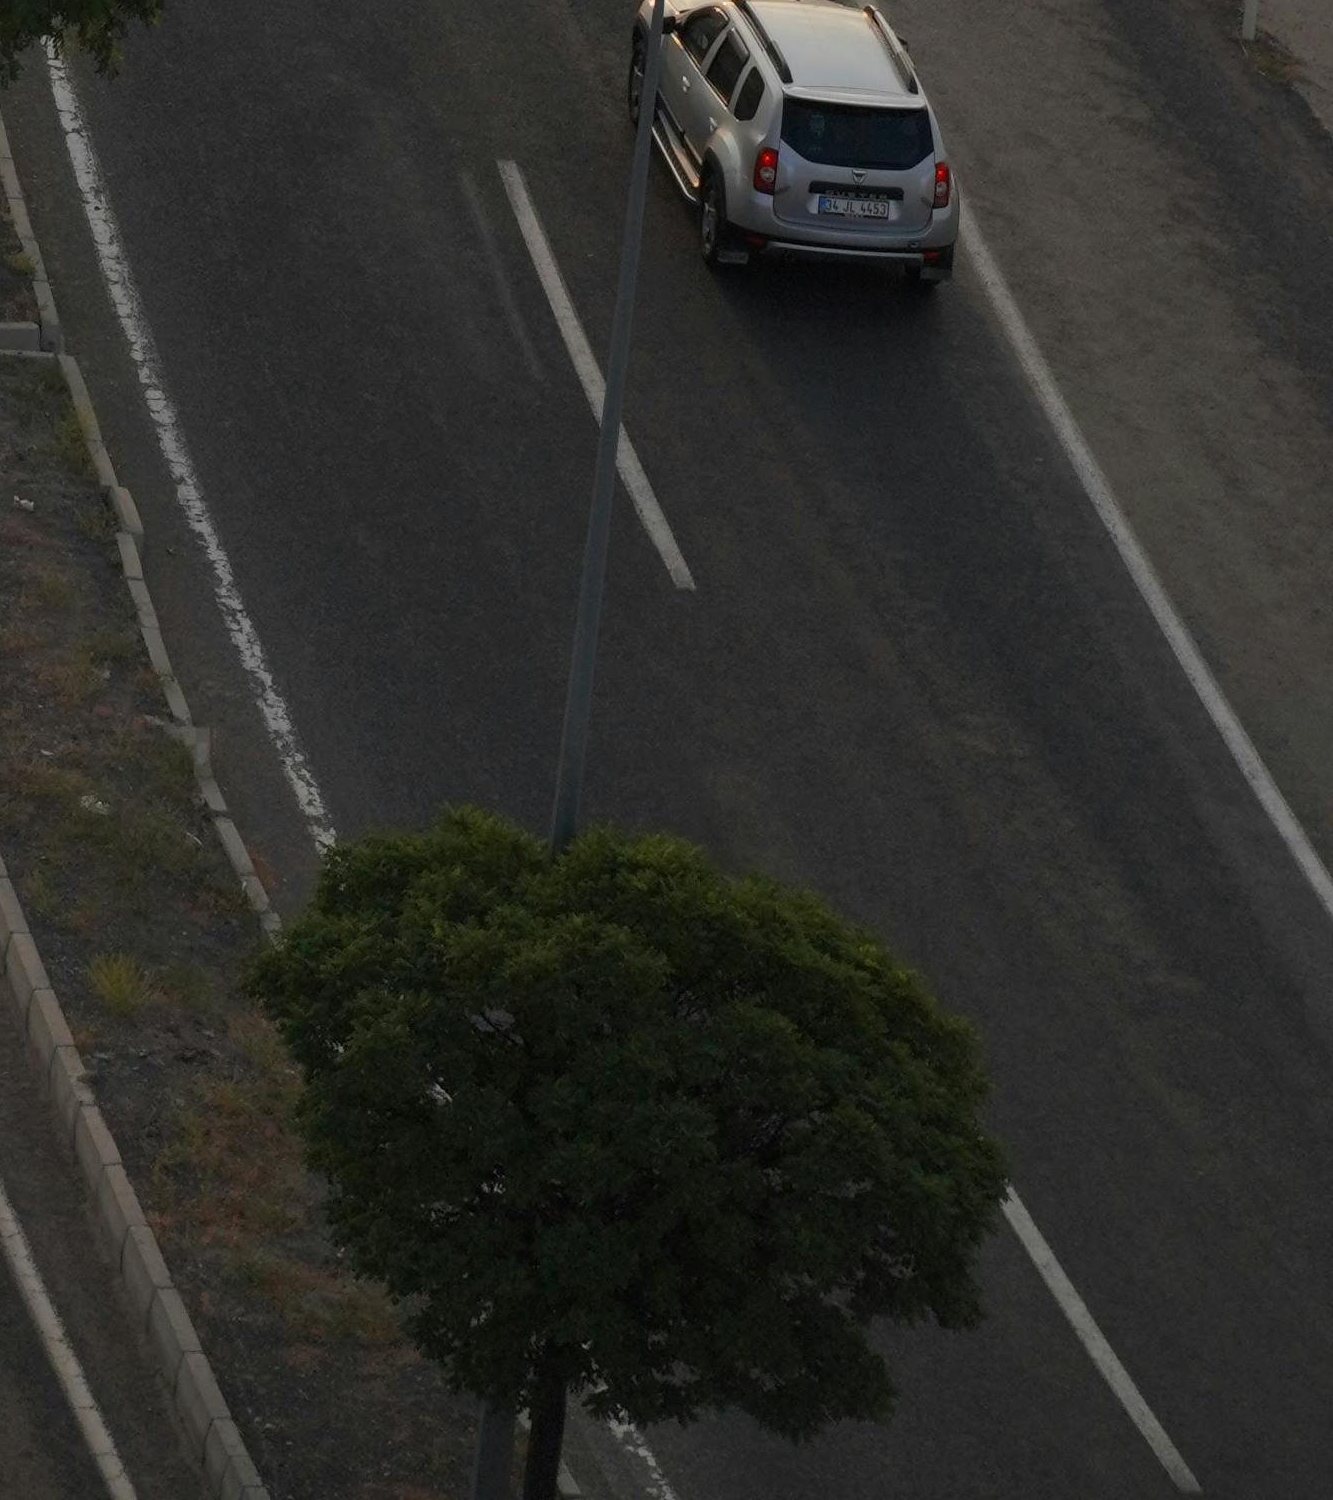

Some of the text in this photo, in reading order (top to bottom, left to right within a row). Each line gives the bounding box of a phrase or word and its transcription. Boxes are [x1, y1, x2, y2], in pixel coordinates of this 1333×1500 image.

[825, 200, 838, 211] 34
[843, 201, 855, 214] JL
[861, 203, 886, 216] 4453
